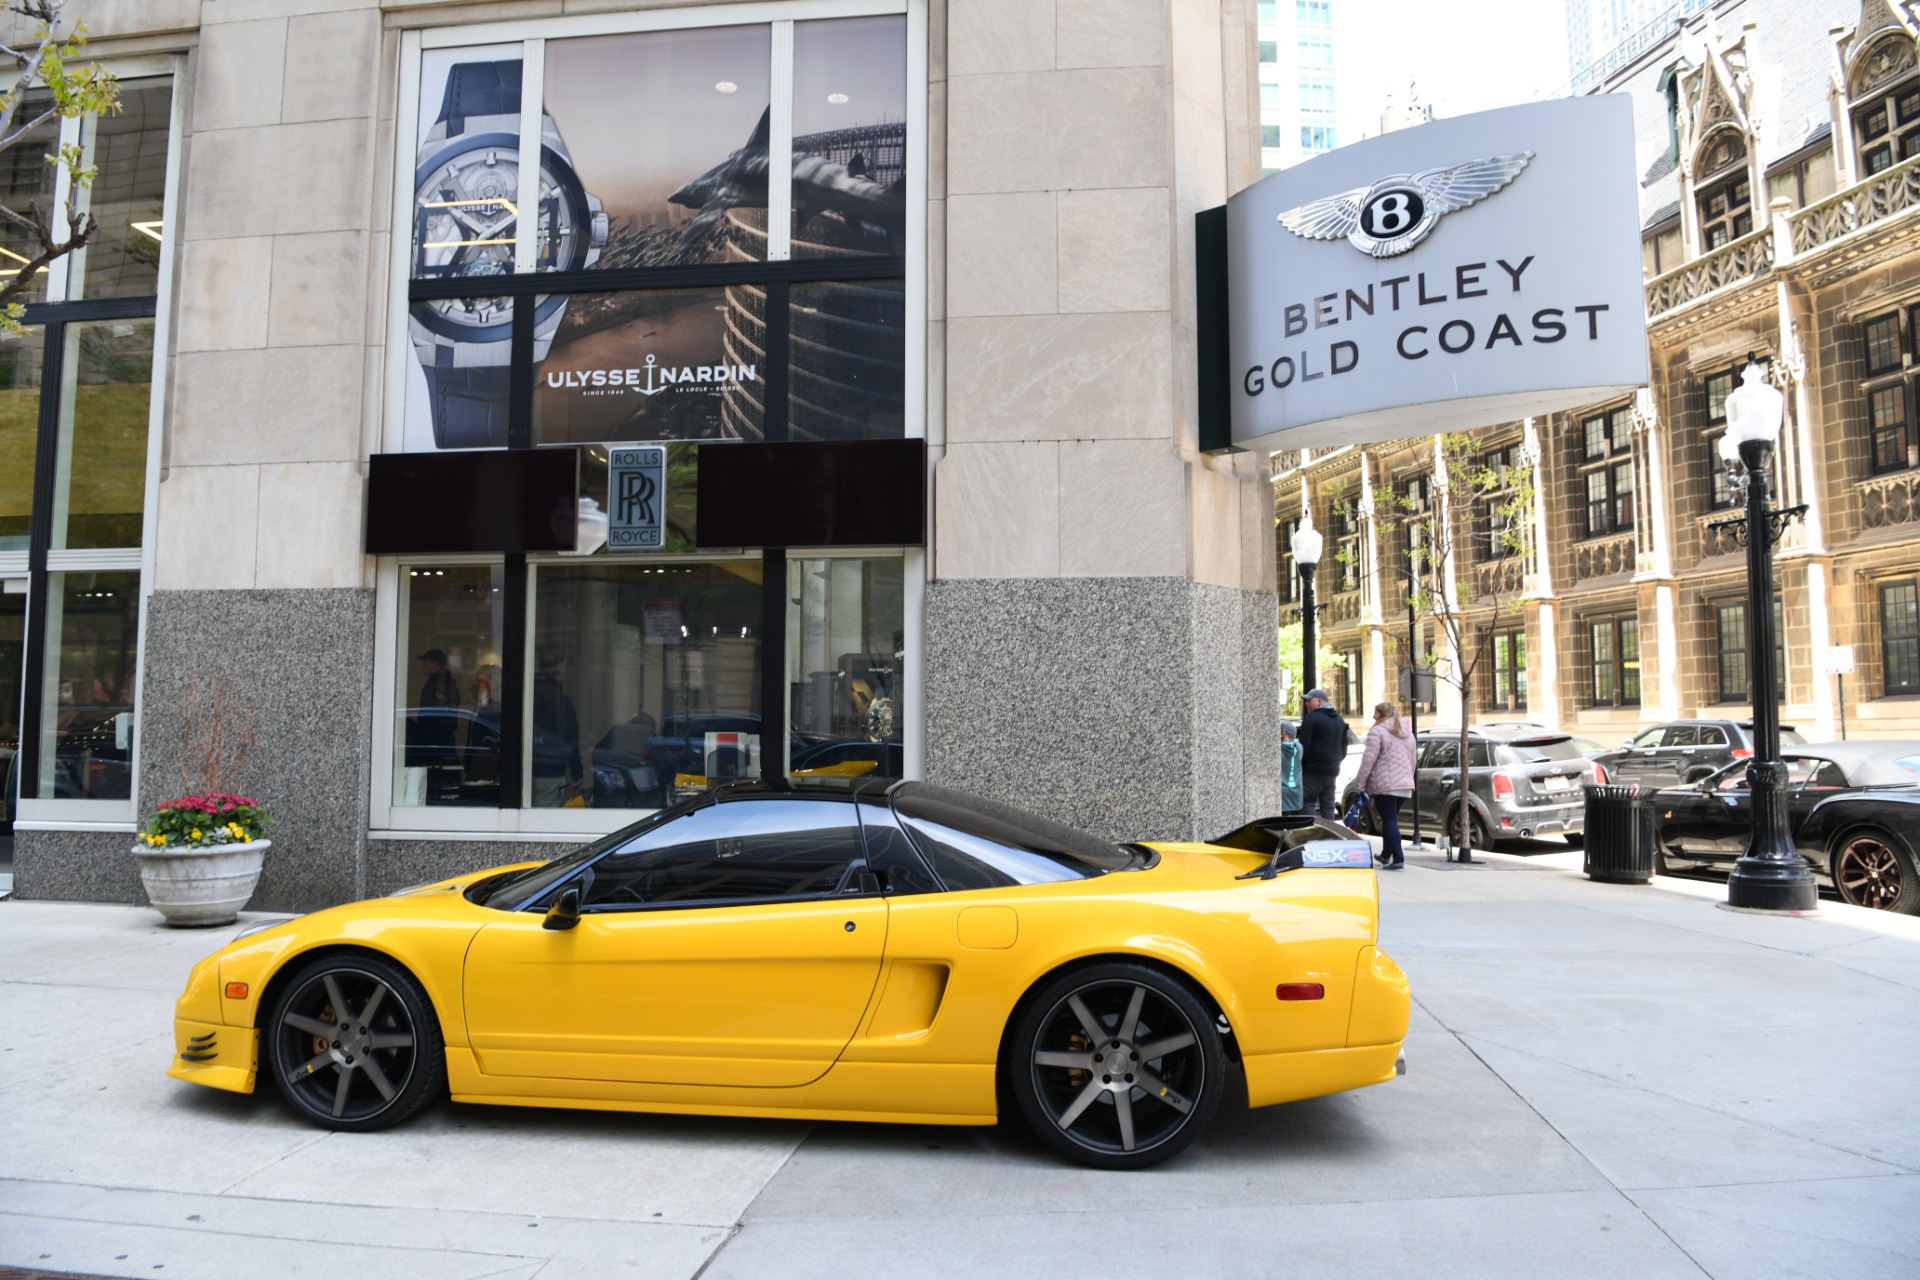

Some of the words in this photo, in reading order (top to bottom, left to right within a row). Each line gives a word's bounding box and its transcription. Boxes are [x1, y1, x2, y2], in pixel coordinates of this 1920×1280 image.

[1371, 193, 1411, 234] B
[1284, 255, 1535, 338] BENTLEY
[1244, 340, 1359, 397] GOLD
[1396, 304, 1609, 360] COAST
[547, 368, 641, 388] ULYSSE
[659, 364, 756, 384] NARDIN
[615, 453, 659, 465] ROLLS
[612, 531, 657, 543] ROYCE
